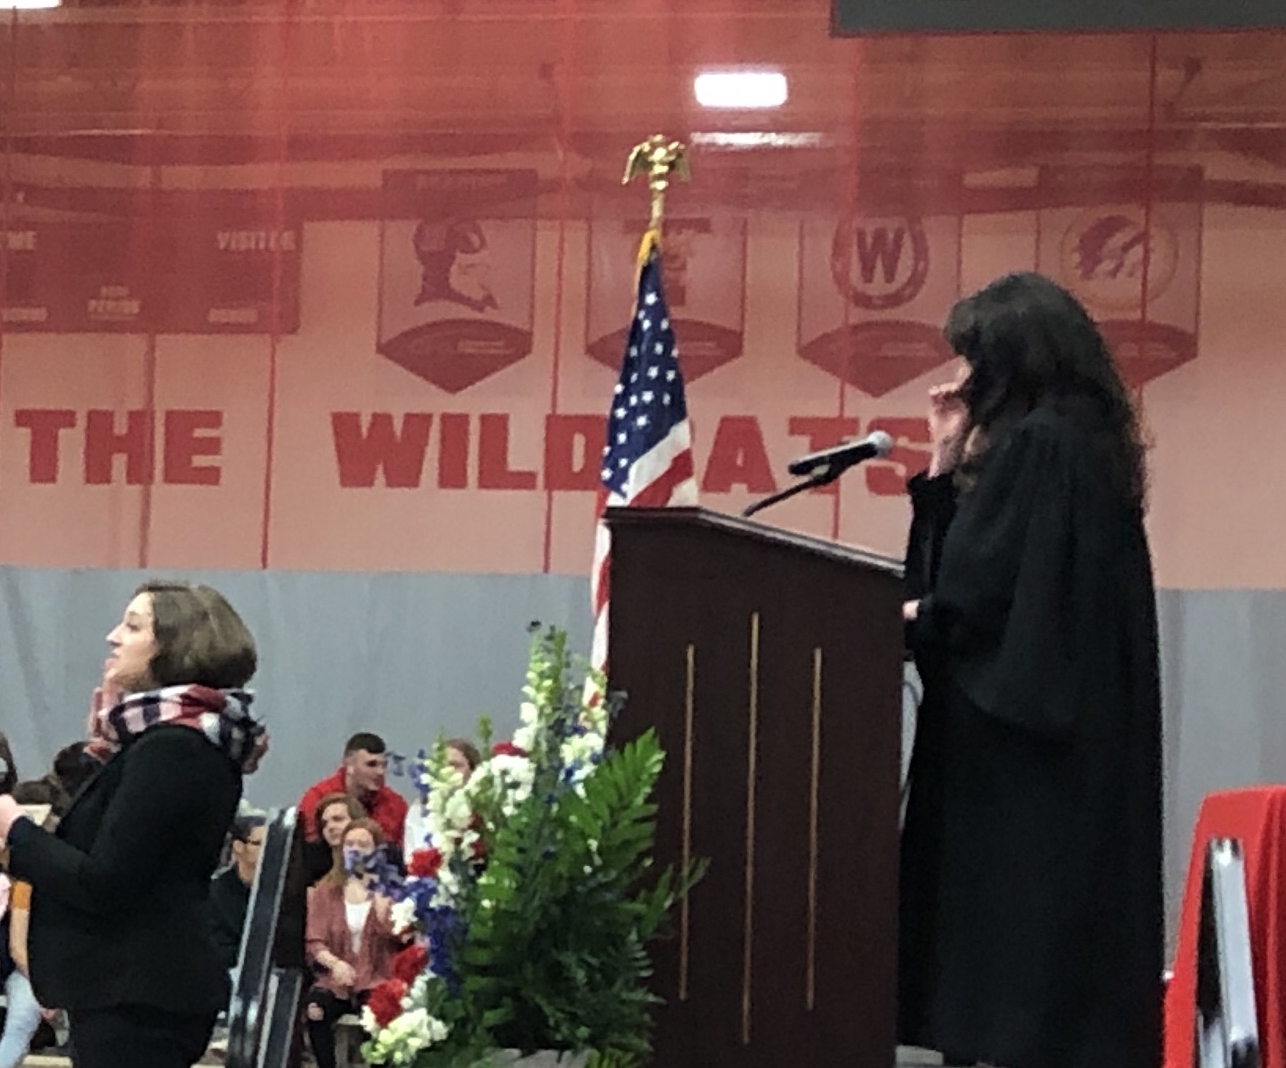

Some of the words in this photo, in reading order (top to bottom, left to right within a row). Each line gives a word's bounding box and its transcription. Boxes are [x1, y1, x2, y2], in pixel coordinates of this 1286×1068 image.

[857, 227, 906, 284] W
[14, 408, 224, 486] THE
[330, 411, 931, 497] WILDATS
